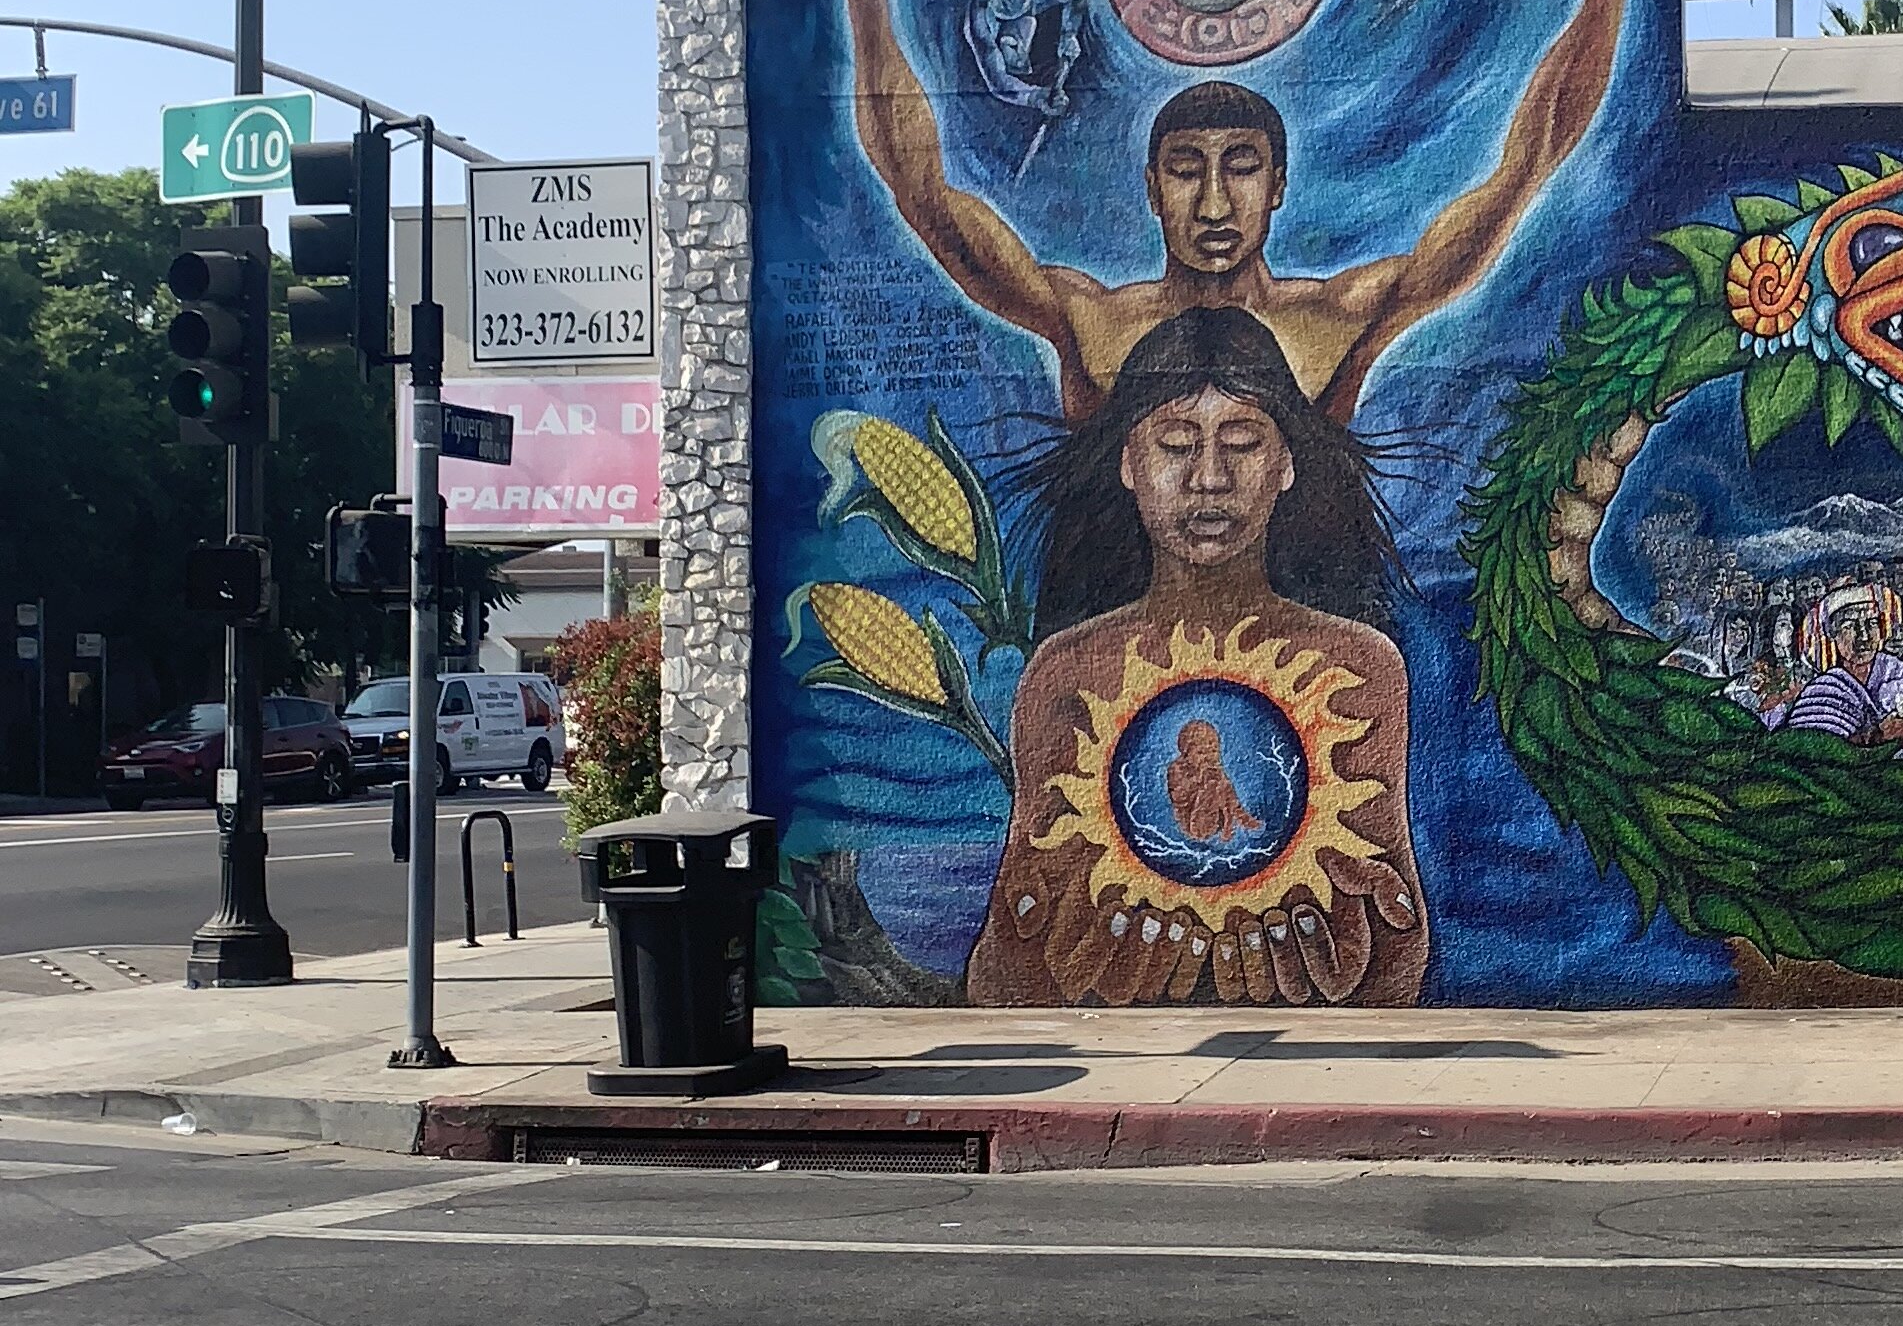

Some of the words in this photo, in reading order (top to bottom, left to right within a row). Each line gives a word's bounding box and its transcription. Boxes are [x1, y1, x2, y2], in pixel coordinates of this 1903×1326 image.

[0, 101, 24, 120] ve
[33, 90, 58, 119] 61
[235, 130, 284, 170] 110
[531, 174, 592, 203] ZMS
[478, 215, 526, 242] The
[532, 212, 646, 245] Academy
[483, 269, 528, 286] NOW
[534, 265, 643, 284] ENROLLING
[481, 309, 645, 347] 323-372-6132
[444, 408, 493, 444] Figueroa
[481, 403, 597, 435] LAR
[447, 484, 638, 511] PARKING
